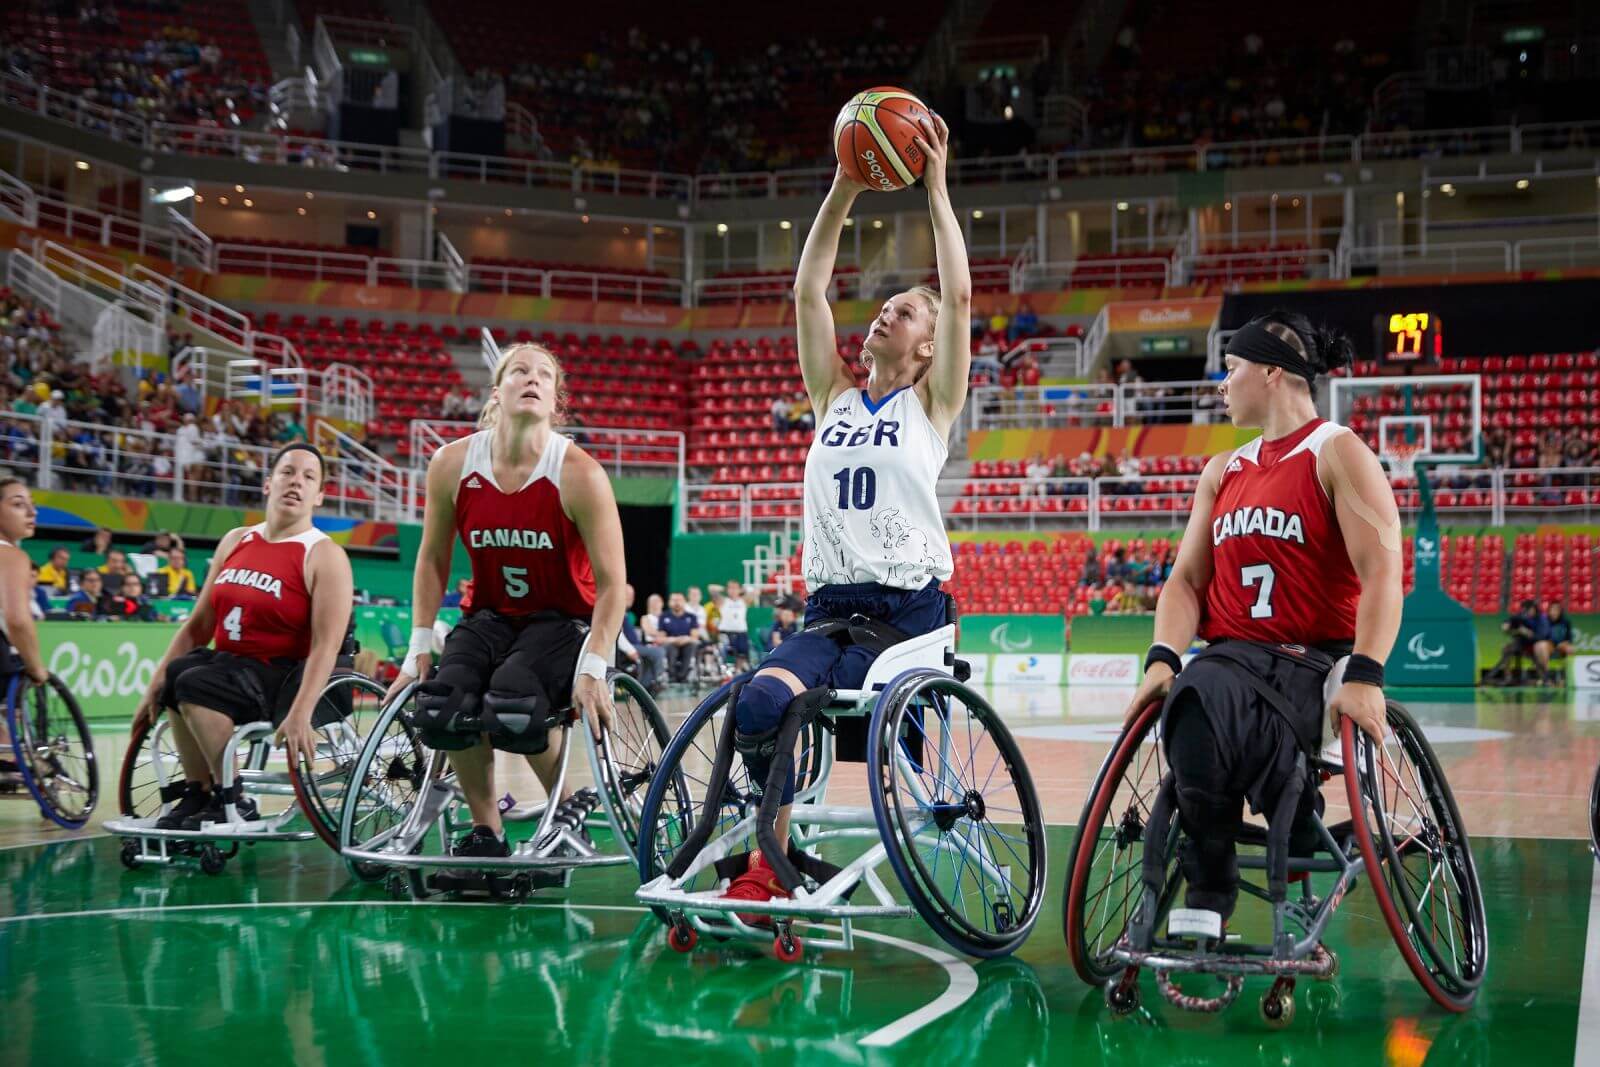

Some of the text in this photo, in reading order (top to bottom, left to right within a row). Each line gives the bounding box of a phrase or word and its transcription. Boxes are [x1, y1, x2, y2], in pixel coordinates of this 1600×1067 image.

[821, 418, 900, 447] GBR
[833, 466, 876, 510] 10
[470, 528, 554, 549] CANADA
[1213, 506, 1305, 546] CANADA
[214, 568, 283, 600] CANADA
[502, 566, 529, 598] 5
[1241, 564, 1275, 619] 7
[223, 606, 243, 641] 4
[48, 641, 164, 697] Rio20
